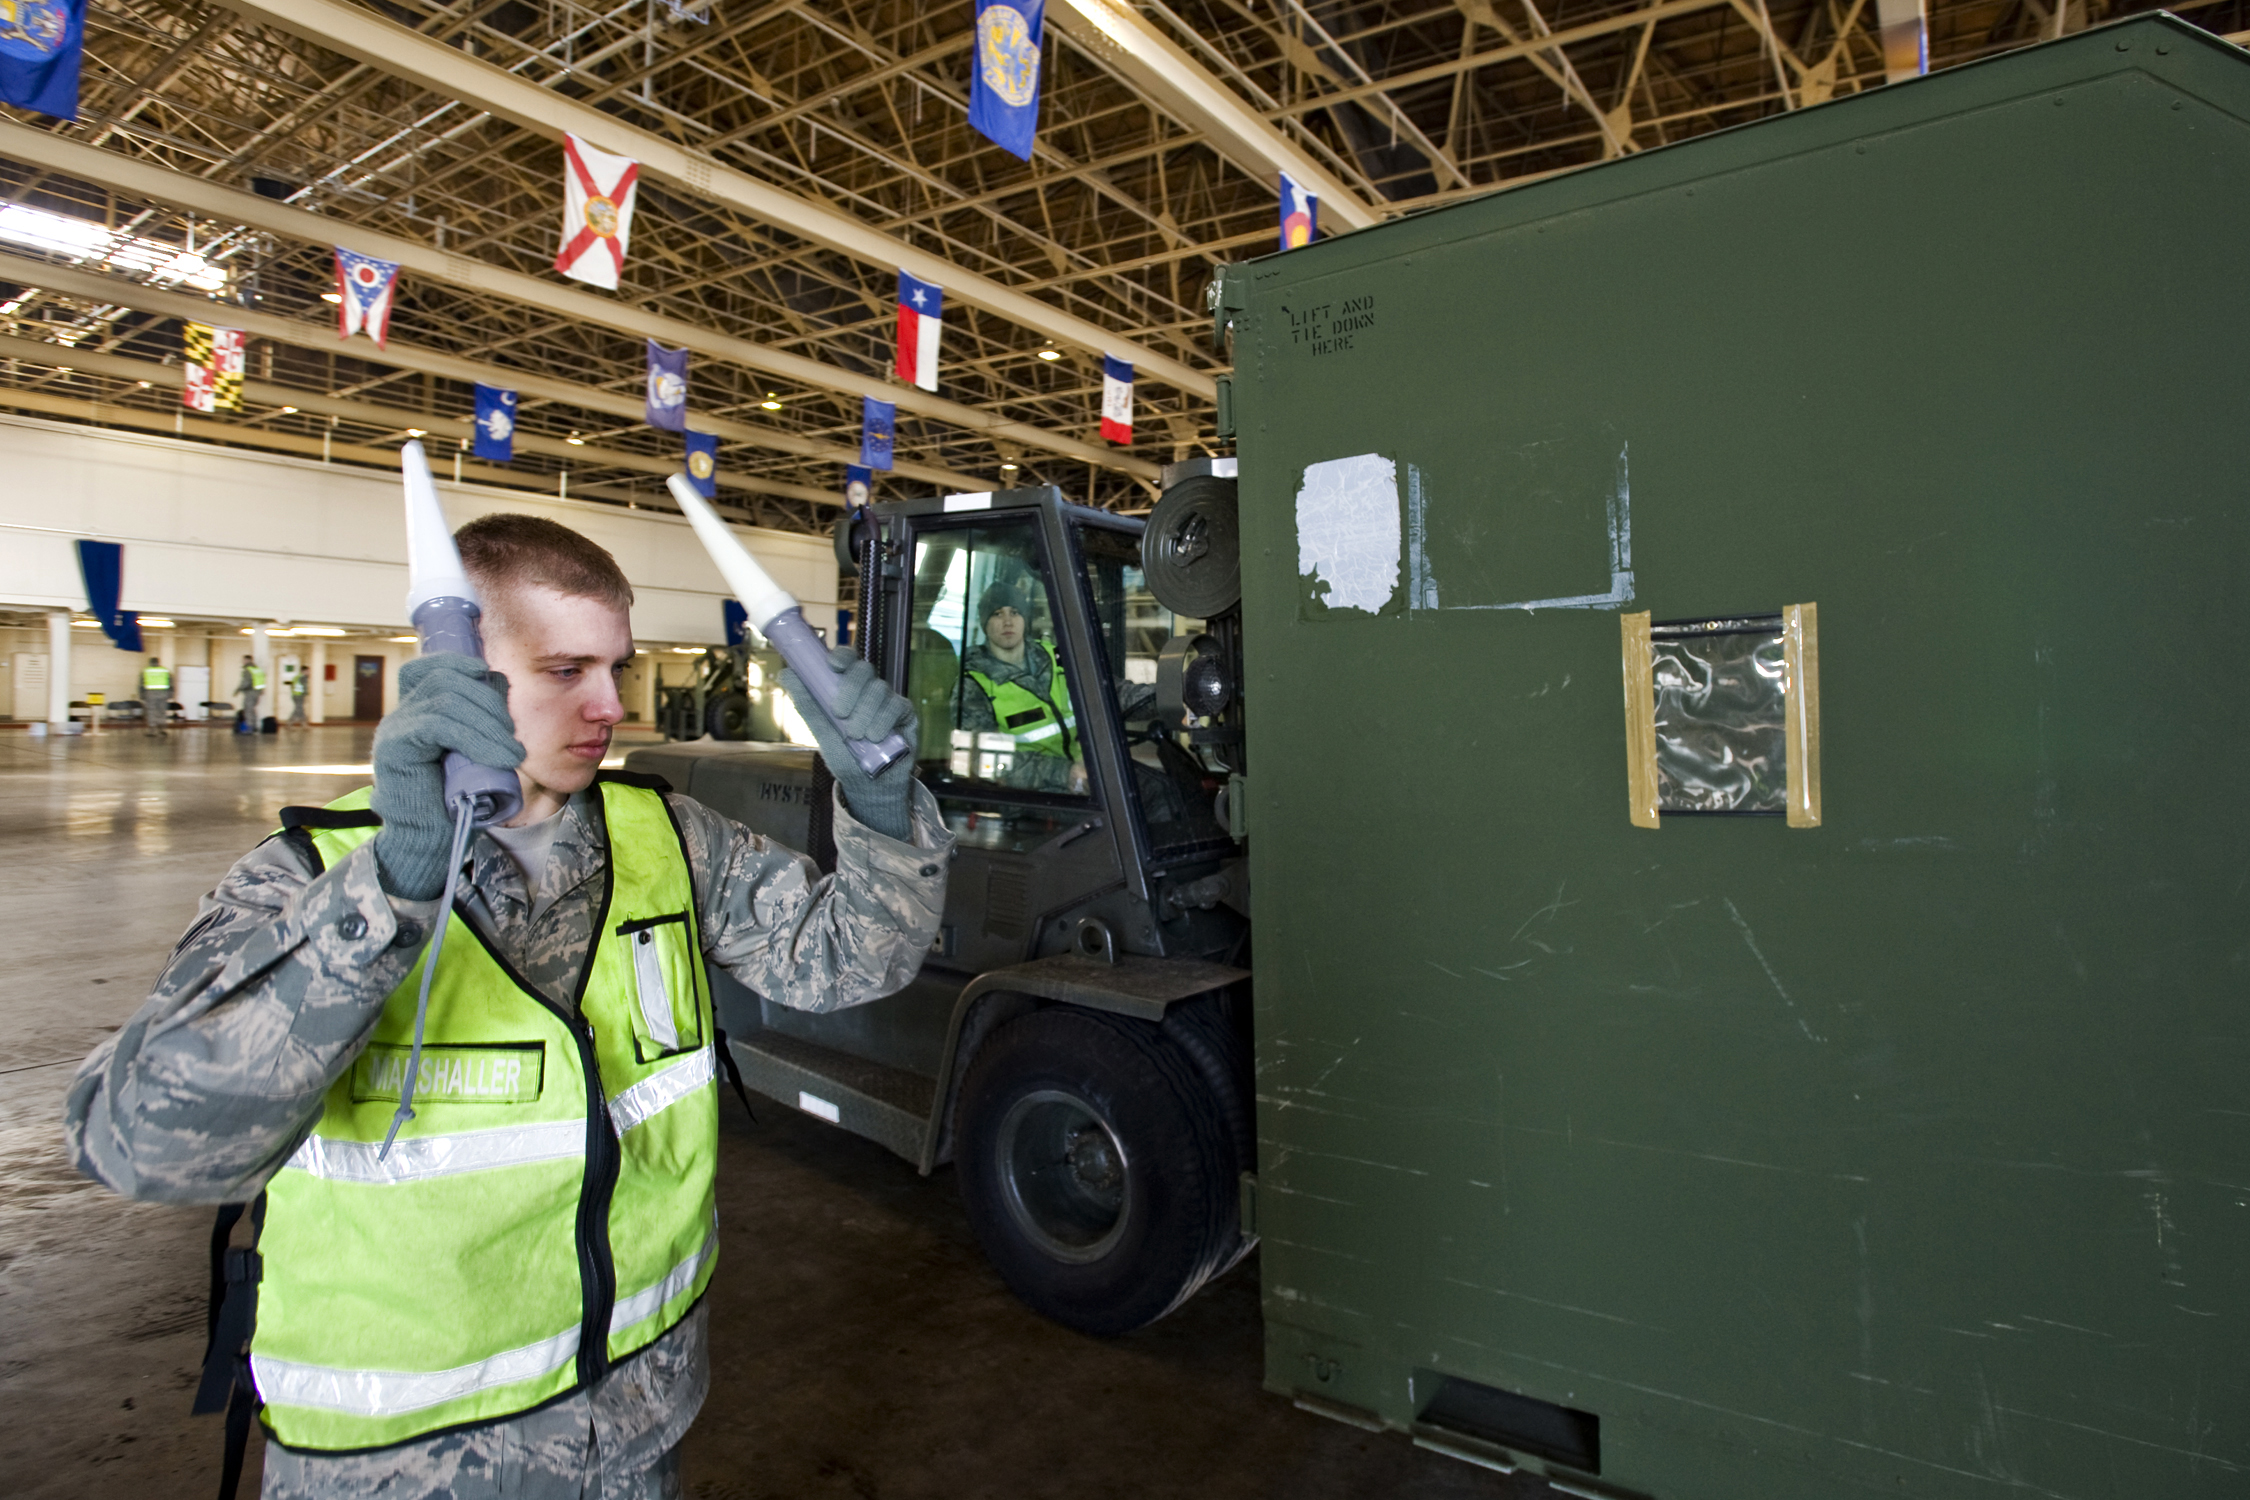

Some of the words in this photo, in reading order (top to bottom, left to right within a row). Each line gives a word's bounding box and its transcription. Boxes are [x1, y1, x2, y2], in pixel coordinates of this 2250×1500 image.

[1291, 305, 1331, 326] LIFT
[1342, 296, 1374, 315] AND
[1291, 325, 1322, 343] TIE
[1332, 312, 1374, 335] DOWN
[1312, 335, 1354, 356] HERE
